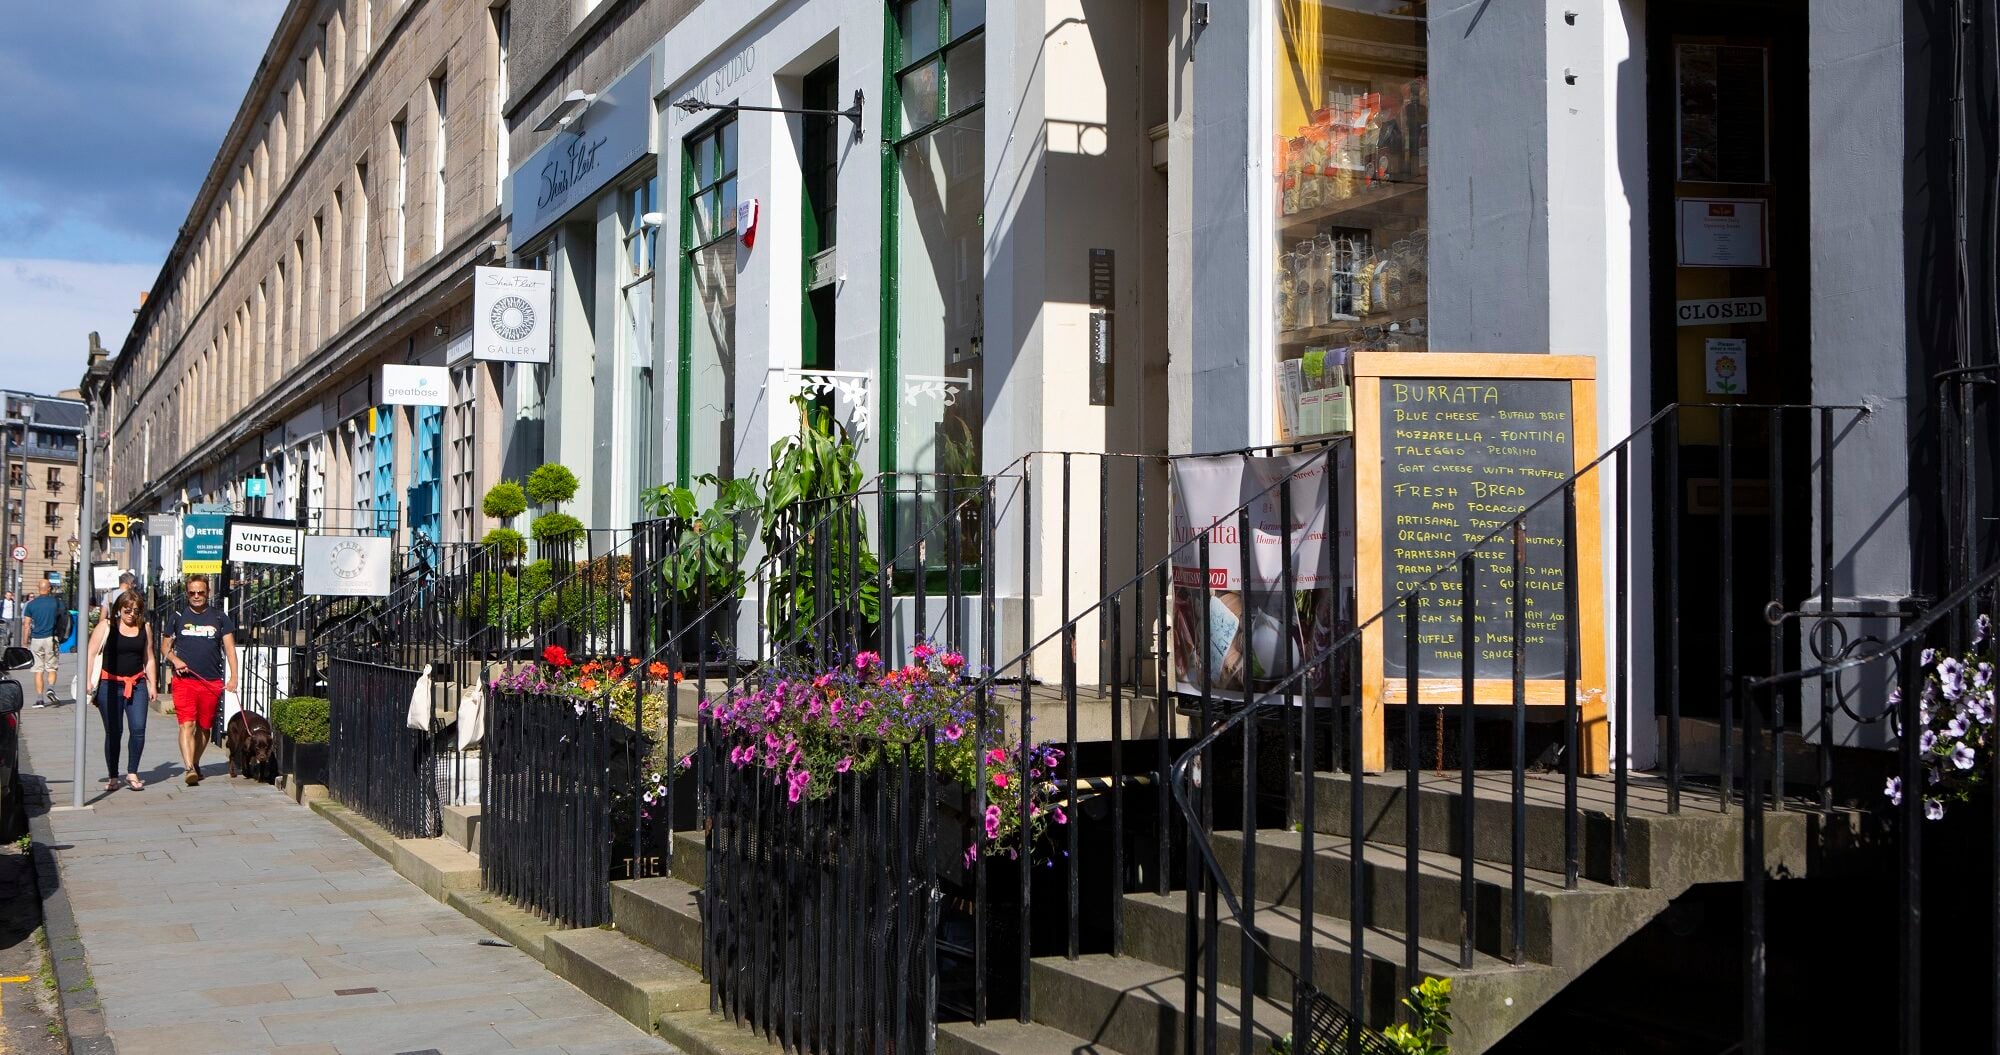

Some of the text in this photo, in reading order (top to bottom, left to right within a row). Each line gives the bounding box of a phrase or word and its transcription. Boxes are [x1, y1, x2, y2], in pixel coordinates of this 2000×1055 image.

[715, 45, 755, 97] STUDIO
[1679, 302, 1762, 320] CLOSED
[487, 344, 536, 355] GALLERY
[388, 388, 438, 397] greatbase
[1392, 383, 1498, 404] BURRATA
[1394, 409, 1428, 422] BLUE
[1435, 412, 1480, 421] CHEESE
[1498, 410, 1535, 421] BUFALO
[1539, 411, 1566, 421] BRIE
[1396, 430, 1483, 442] MOZZARELLA
[1500, 430, 1565, 443] FONTINA
[1394, 446, 1465, 456] TALEGGIO
[1486, 445, 1537, 456] PECORINO
[1398, 463, 1566, 480] GOAT CHEESE WITH TRUFFLE
[1393, 481, 1526, 499] FRESH BREAD
[1432, 502, 1526, 513] AND FOCACCIA
[1397, 515, 1460, 527] ARTISANAL
[197, 528, 224, 536] RETTIE
[1398, 529, 1452, 543] ORGANIC
[242, 533, 292, 544] VINTAGE
[1256, 534, 1276, 544] Home
[236, 543, 297, 555] BOUTIQUE
[1394, 549, 1506, 559] PARMESAN HEESE
[1396, 565, 1431, 574] PARMA
[1436, 564, 1458, 572] HM
[1541, 567, 1563, 576] HAM
[1440, 582, 1463, 591] BEE
[1525, 622, 1557, 631] COFFEE
[1486, 633, 1544, 644] MUSHOMS
